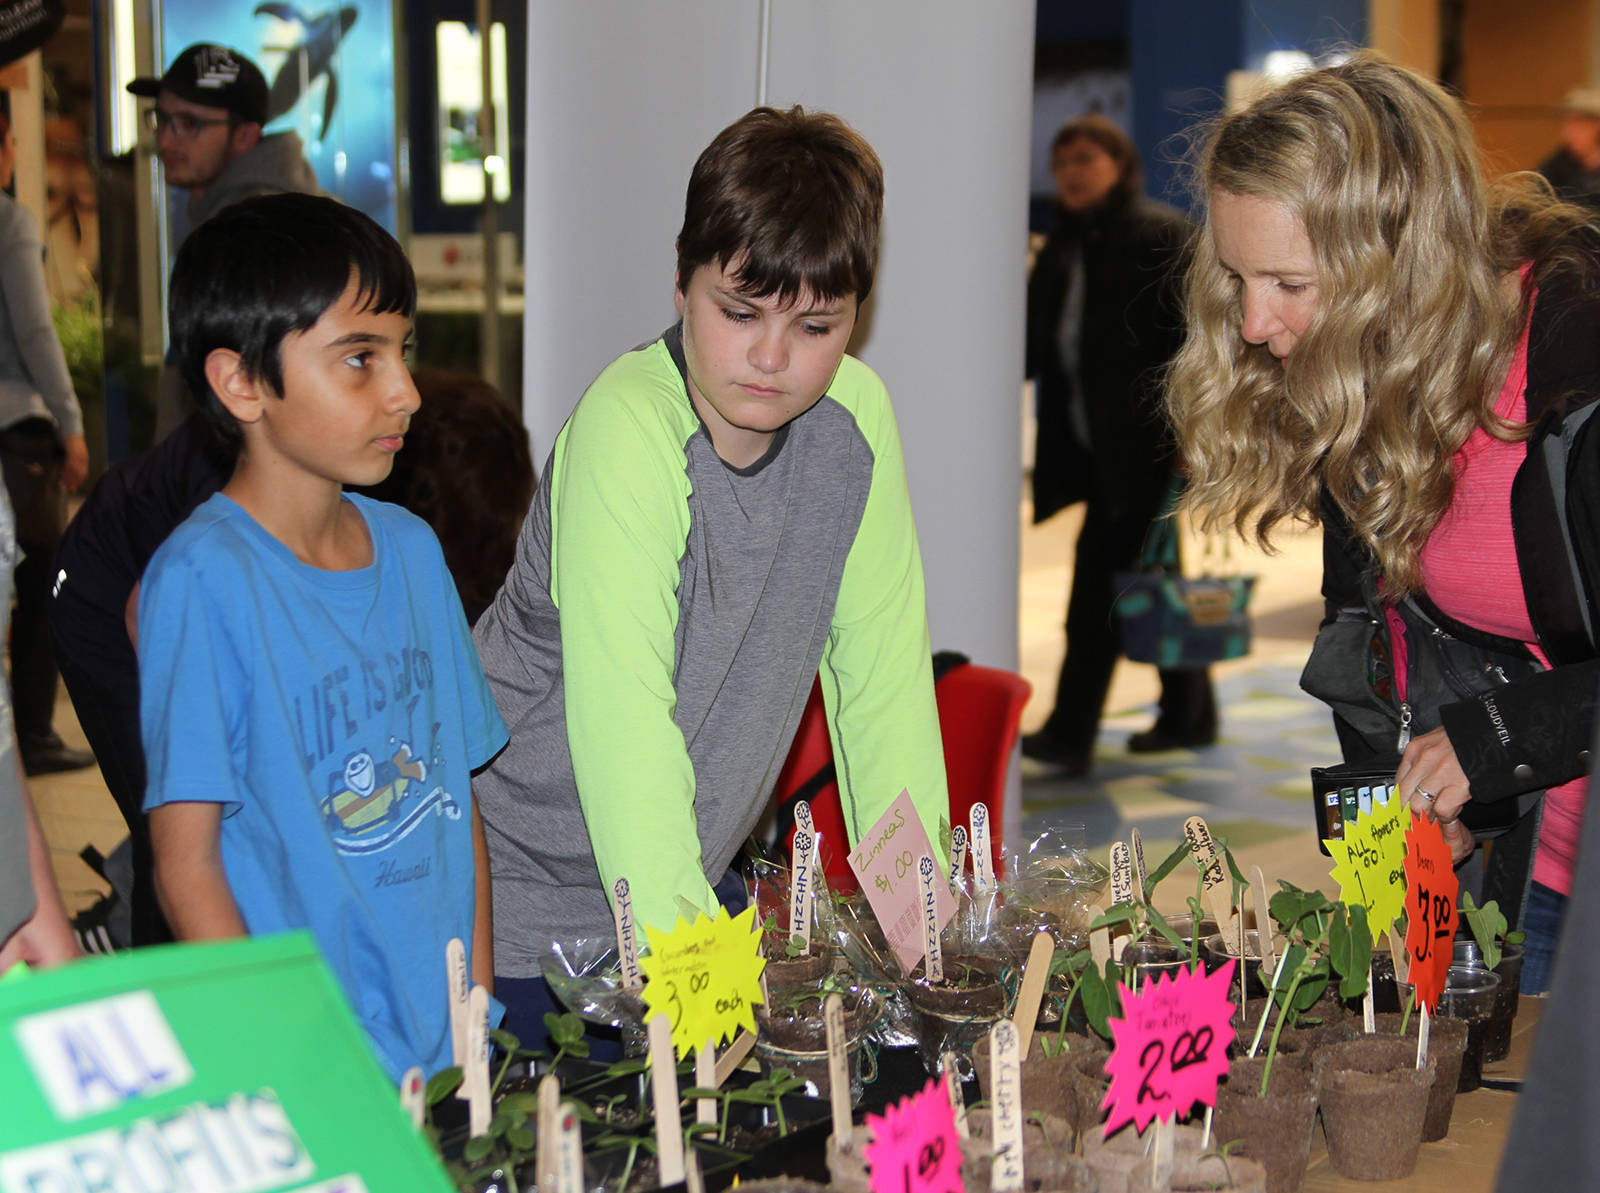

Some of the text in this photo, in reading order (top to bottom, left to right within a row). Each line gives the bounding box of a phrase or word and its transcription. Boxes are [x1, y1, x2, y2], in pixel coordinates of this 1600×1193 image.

[294, 665, 359, 773] LIFE
[361, 658, 387, 720] IS
[374, 856, 432, 888] Hawaii
[1347, 839, 1371, 865] ALL
[793, 865, 808, 931] ZINNI
[926, 891, 940, 978] ZINNIA
[715, 987, 744, 1015] each
